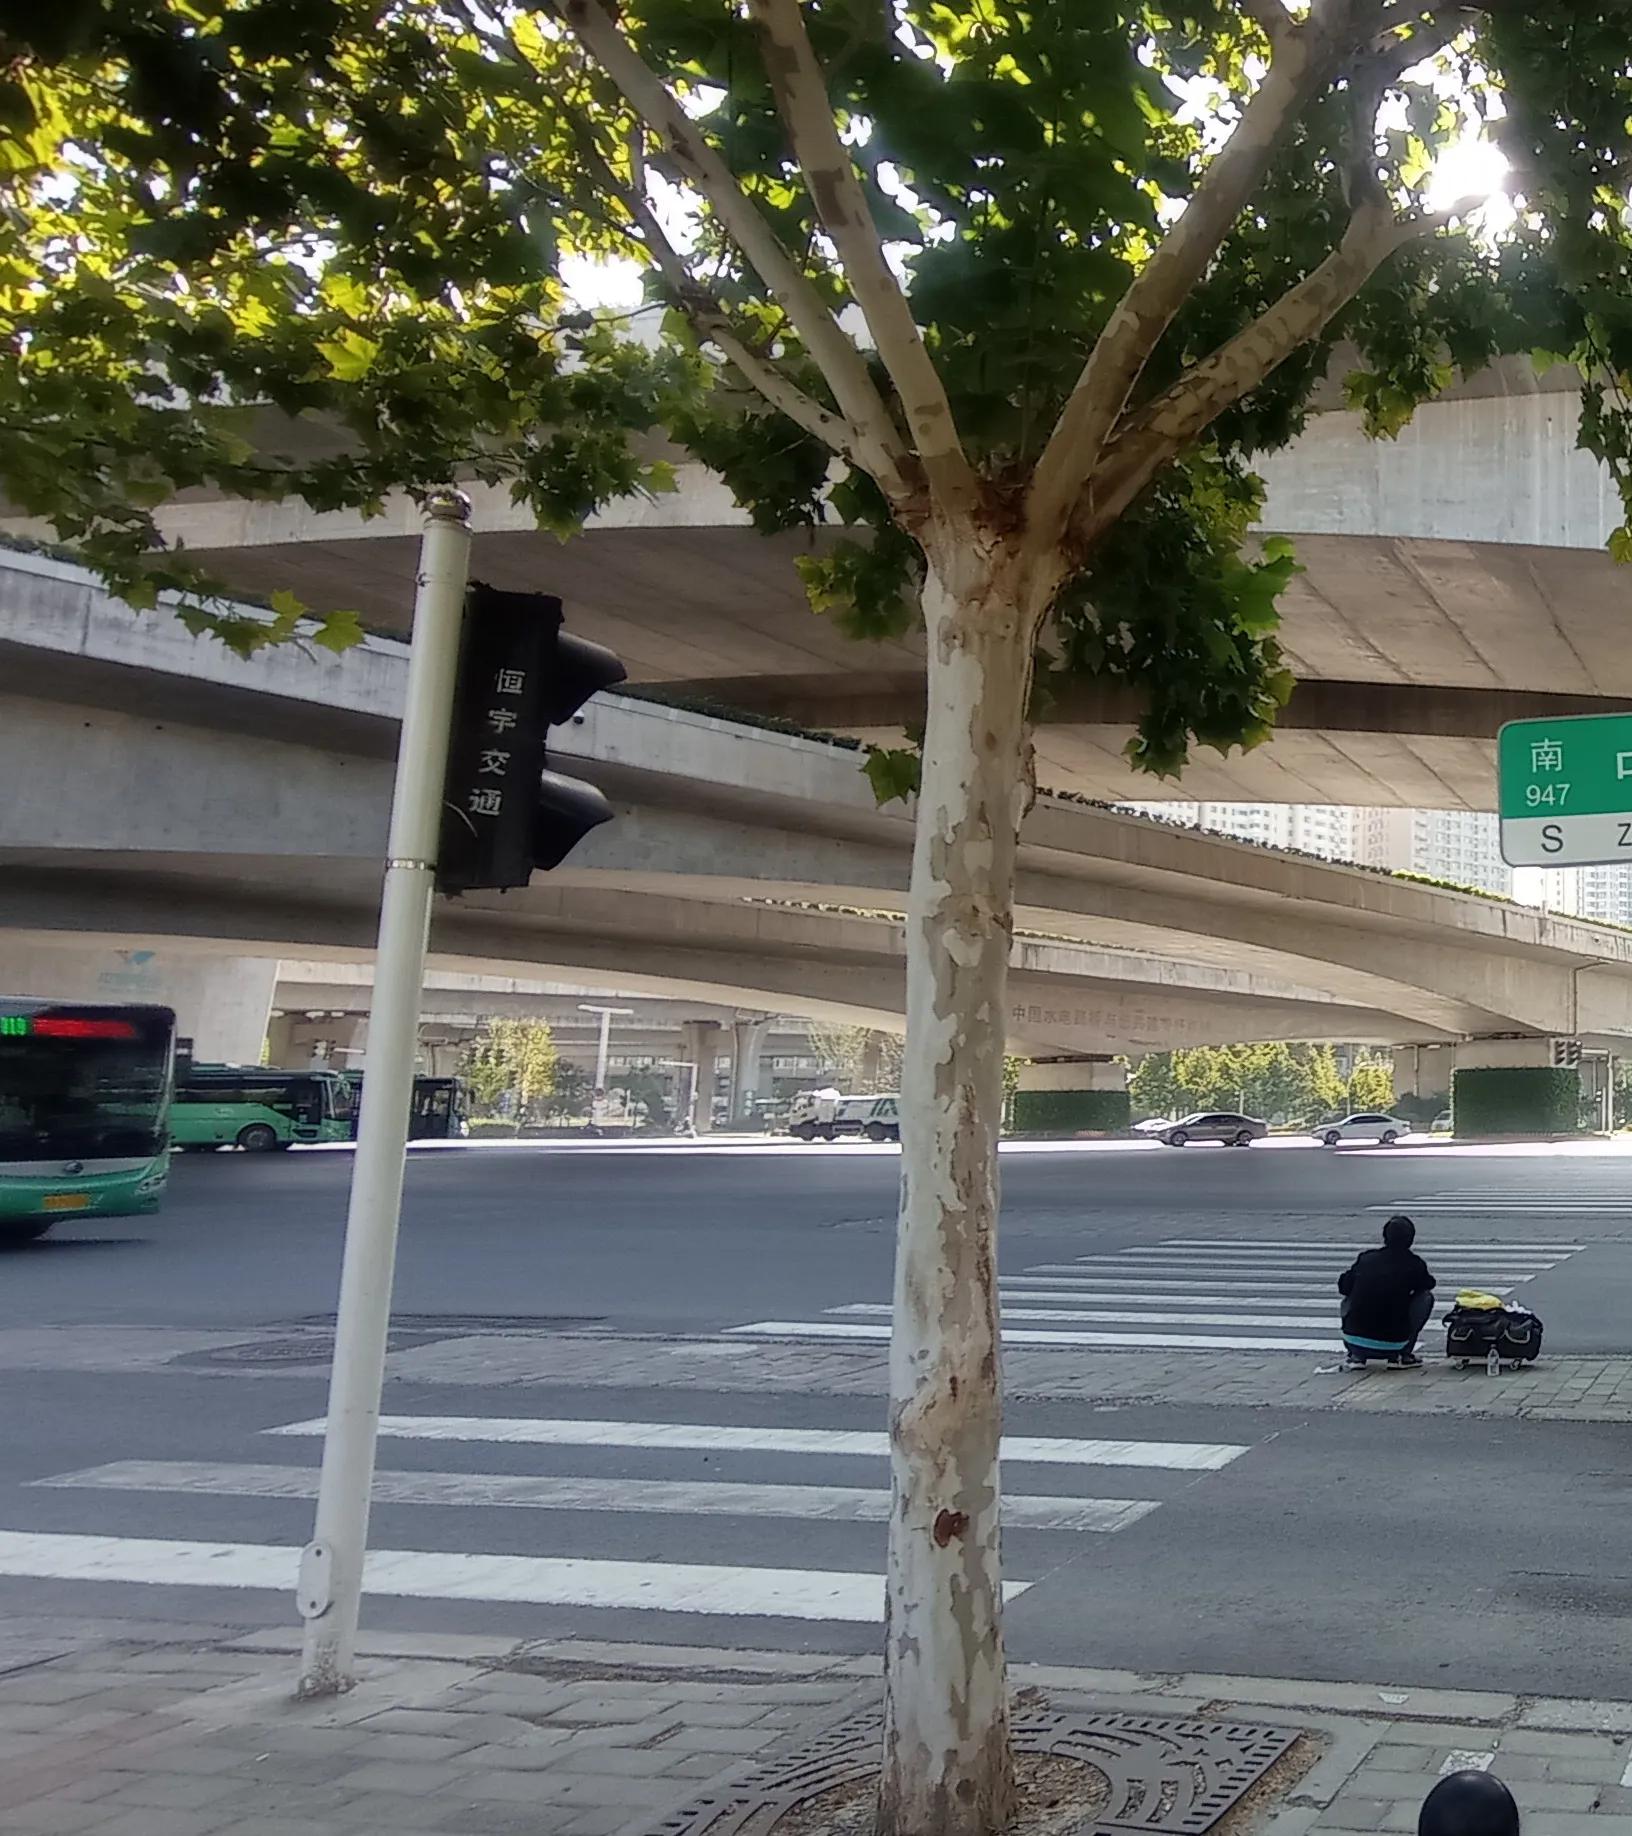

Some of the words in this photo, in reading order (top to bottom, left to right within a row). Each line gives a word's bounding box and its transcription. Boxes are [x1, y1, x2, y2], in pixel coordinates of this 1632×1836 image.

[468, 668, 525, 816] 恒宇交通
[1530, 738, 1563, 773] 南
[1525, 783, 1571, 807] 947
[1541, 824, 1564, 853] S
